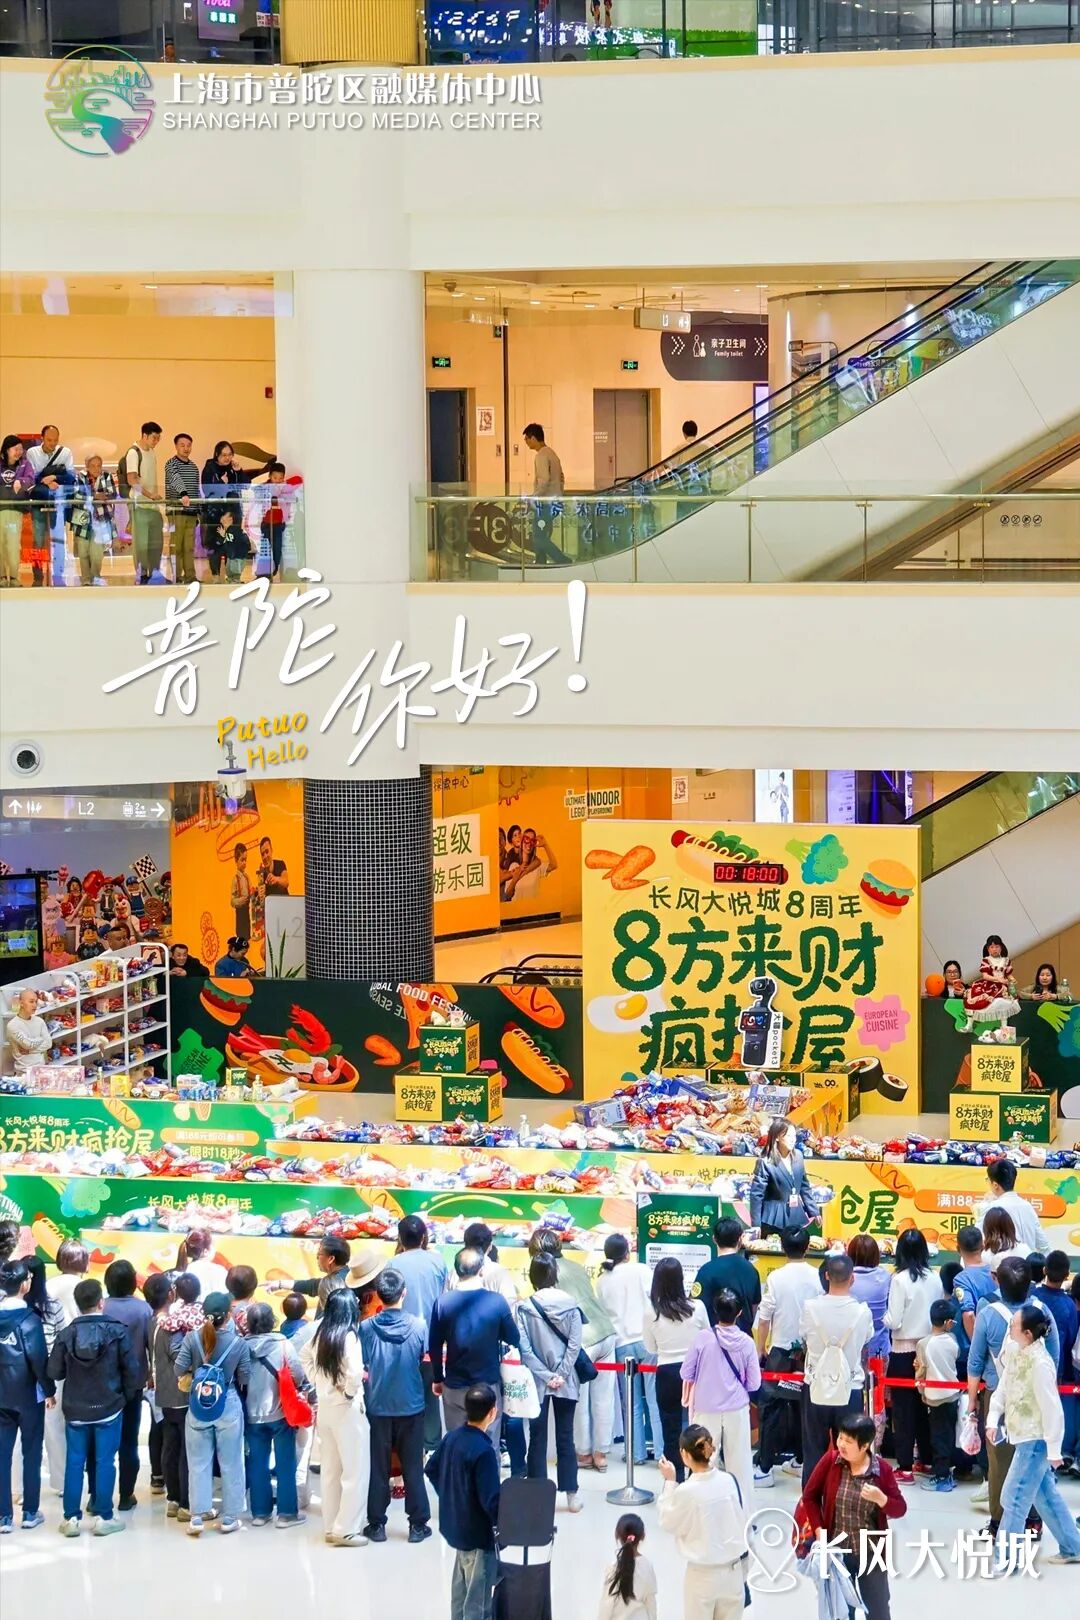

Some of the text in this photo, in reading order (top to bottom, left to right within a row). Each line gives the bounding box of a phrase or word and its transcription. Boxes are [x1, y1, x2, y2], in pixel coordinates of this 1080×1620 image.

[711, 338, 747, 349] 亲子卫生间
[587, 790, 620, 806] INDOOR
[78, 801, 95, 815] L2
[433, 822, 472, 857] 超级
[433, 862, 484, 894] 游乐园
[715, 866, 779, 882] 00:18:00
[648, 885, 863, 919] 长风大悦城8周年
[612, 909, 884, 1001] 8方来财
[396, 983, 429, 1002] FOOD
[864, 1009, 898, 1019] EUROPEAN
[866, 1019, 899, 1032] CUISINE
[977, 1058, 1015, 1070] 8方来财
[981, 1070, 1011, 1083] 疯抢屋
[401, 1089, 436, 1099] 8方来财
[405, 1099, 433, 1112] 疯抢屋
[955, 1107, 993, 1119] 8方来财
[5, 1115, 71, 1128] 长风大悦城8周年
[959, 1119, 990, 1131] 疯抢屋
[648, 1214, 710, 1227] 8方来财疯抢屋
